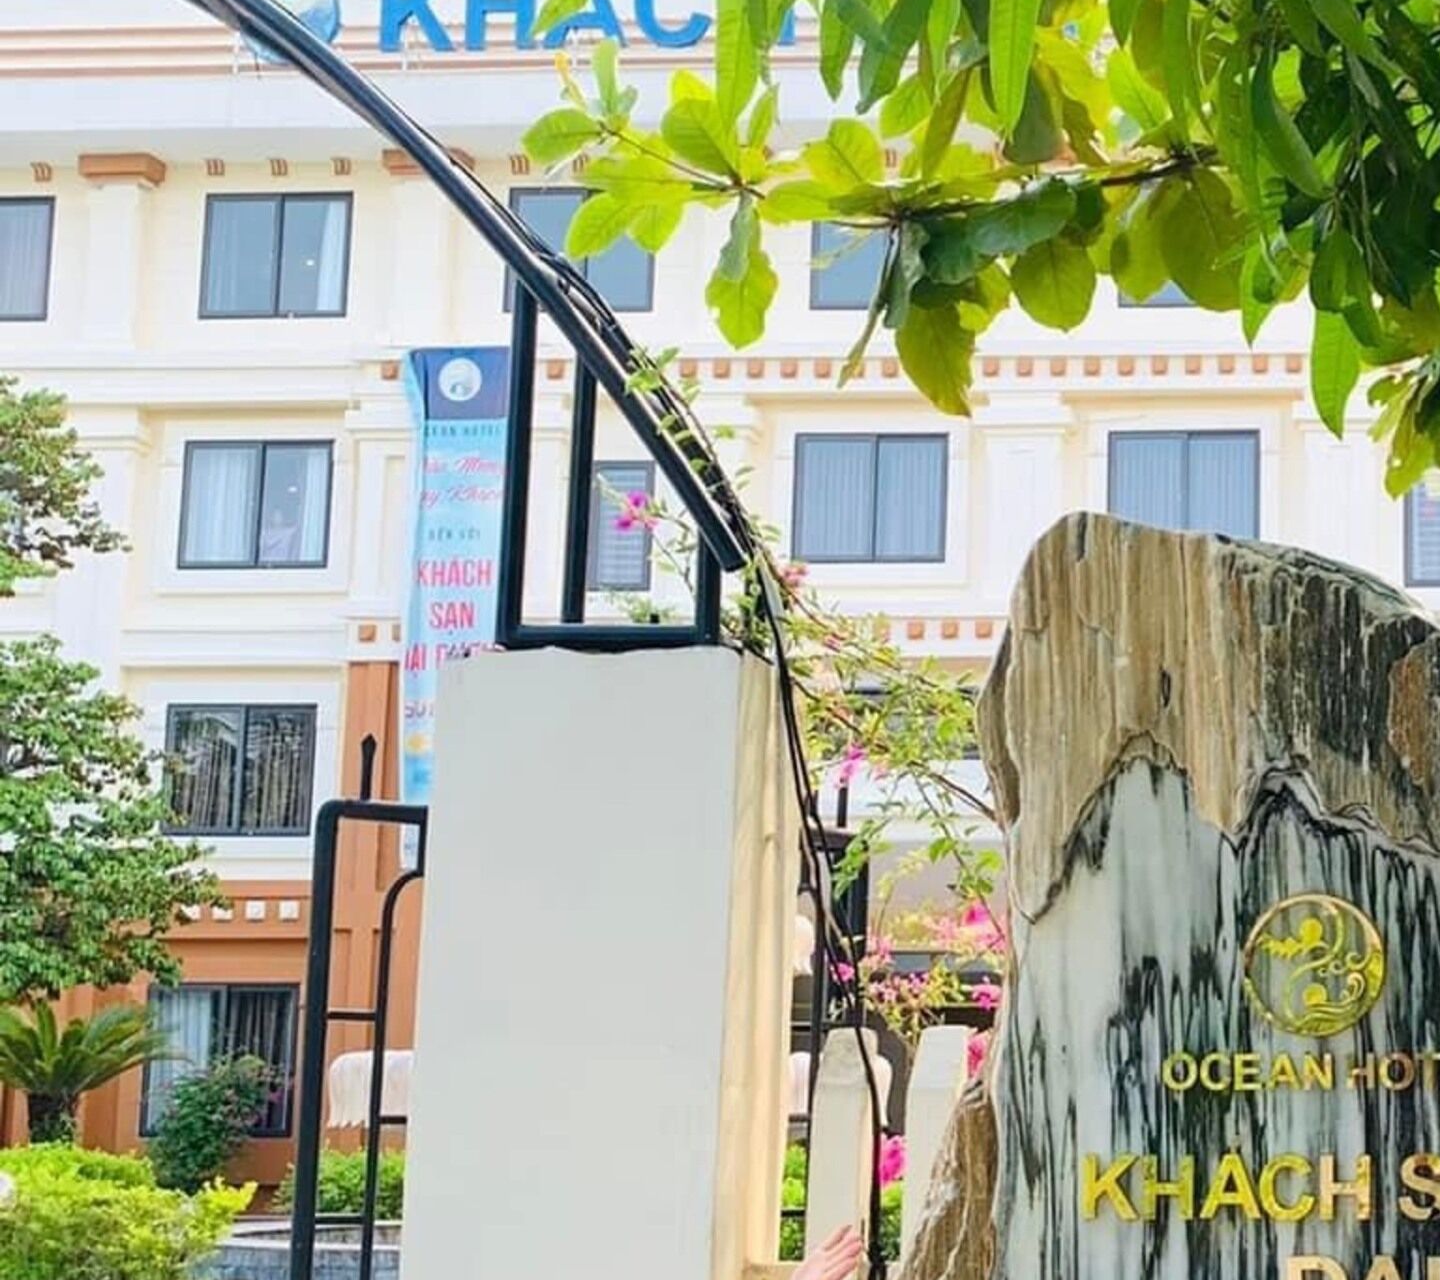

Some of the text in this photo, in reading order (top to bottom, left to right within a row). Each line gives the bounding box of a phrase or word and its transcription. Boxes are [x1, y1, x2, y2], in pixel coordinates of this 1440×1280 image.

[429, 601, 475, 635] SẠN
[1161, 1051, 1333, 1093] OCEAN
[1079, 1132, 1374, 1222] KHÁCH
